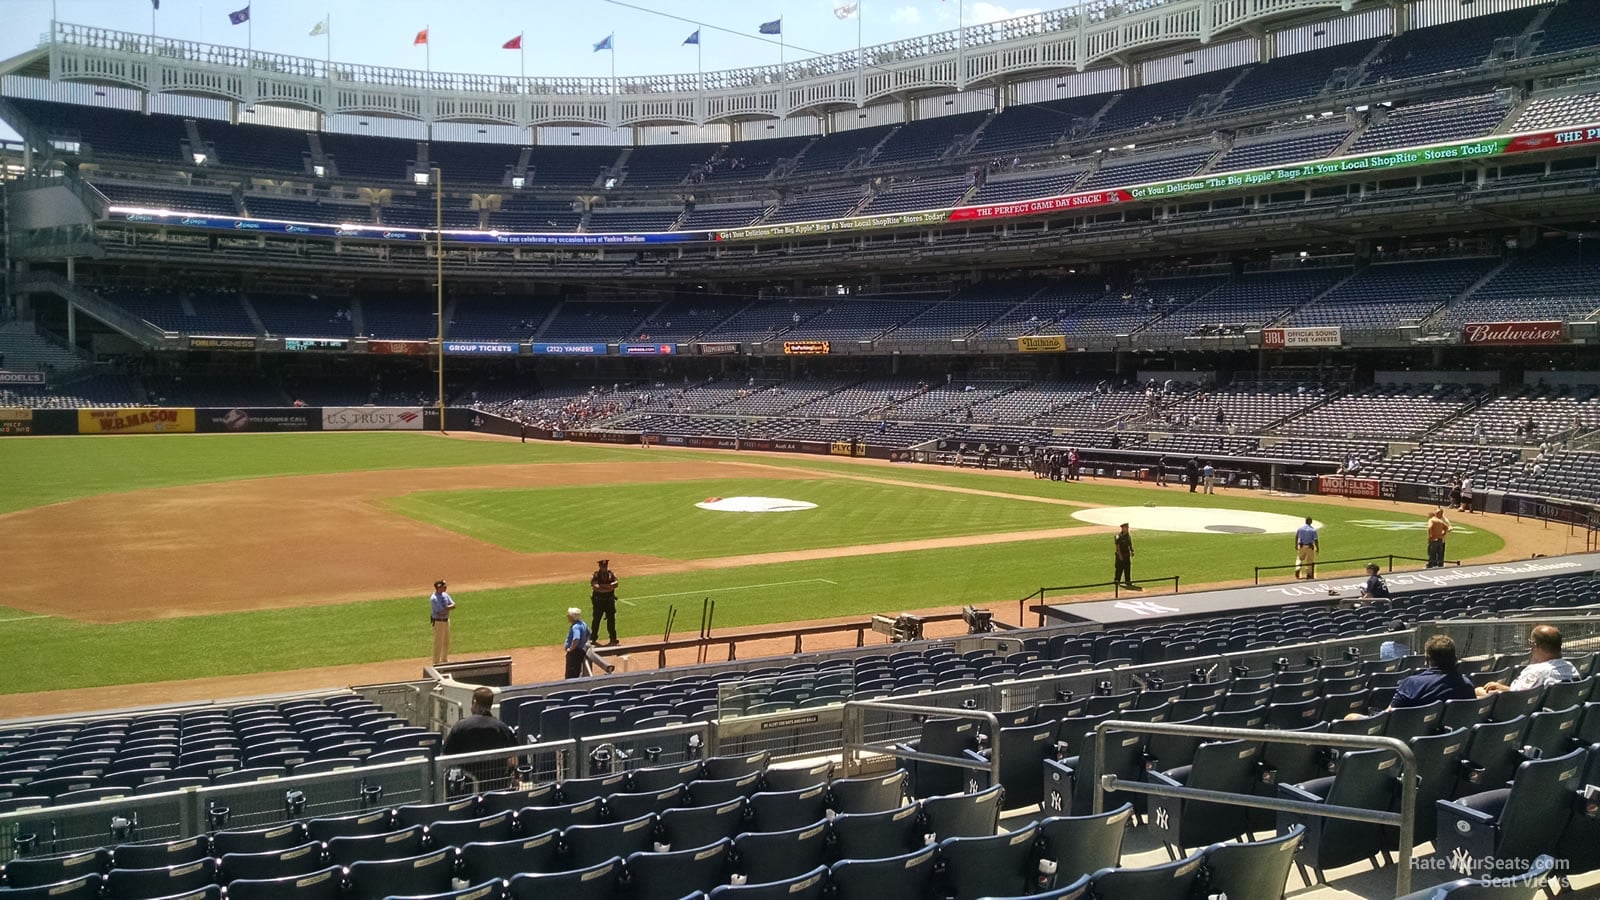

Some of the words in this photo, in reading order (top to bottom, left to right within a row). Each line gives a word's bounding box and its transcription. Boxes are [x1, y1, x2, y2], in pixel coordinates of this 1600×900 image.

[1555, 130, 1583, 143] THE
[1131, 188, 1146, 198] Get
[1147, 186, 1165, 196] Your
[1167, 181, 1204, 194] Delicious
[1227, 175, 1242, 187] Big
[1278, 168, 1301, 180] Bags
[1303, 166, 1315, 175] At
[1316, 163, 1338, 174] Your
[1341, 158, 1369, 171] Local
[1424, 148, 1458, 160] Stores
[1461, 141, 1498, 157] Today!
[977, 207, 992, 217] THE
[994, 204, 1029, 215] PERFECT
[1031, 200, 1054, 211] GAME
[1055, 198, 1070, 209] DAY
[1072, 194, 1102, 207] SNACK!
[745, 229, 770, 237] Delicious
[785, 226, 795, 234] Big
[816, 223, 830, 232] Bags
[839, 221, 853, 229] Your
[854, 219, 871, 227] Local
[903, 215, 923, 223] Stores
[924, 212, 946, 221] Today!
[497, 235, 508, 243] You
[547, 236, 558, 244] any
[604, 235, 622, 243] Yankee
[623, 235, 645, 243] Stadium
[1264, 331, 1284, 344] JBL
[1465, 324, 1560, 341] Budweiser
[449, 344, 477, 352] GROUP
[327, 414, 350, 424] U.S.
[354, 413, 394, 424] TRUST
[1266, 582, 1363, 596] Welcom
